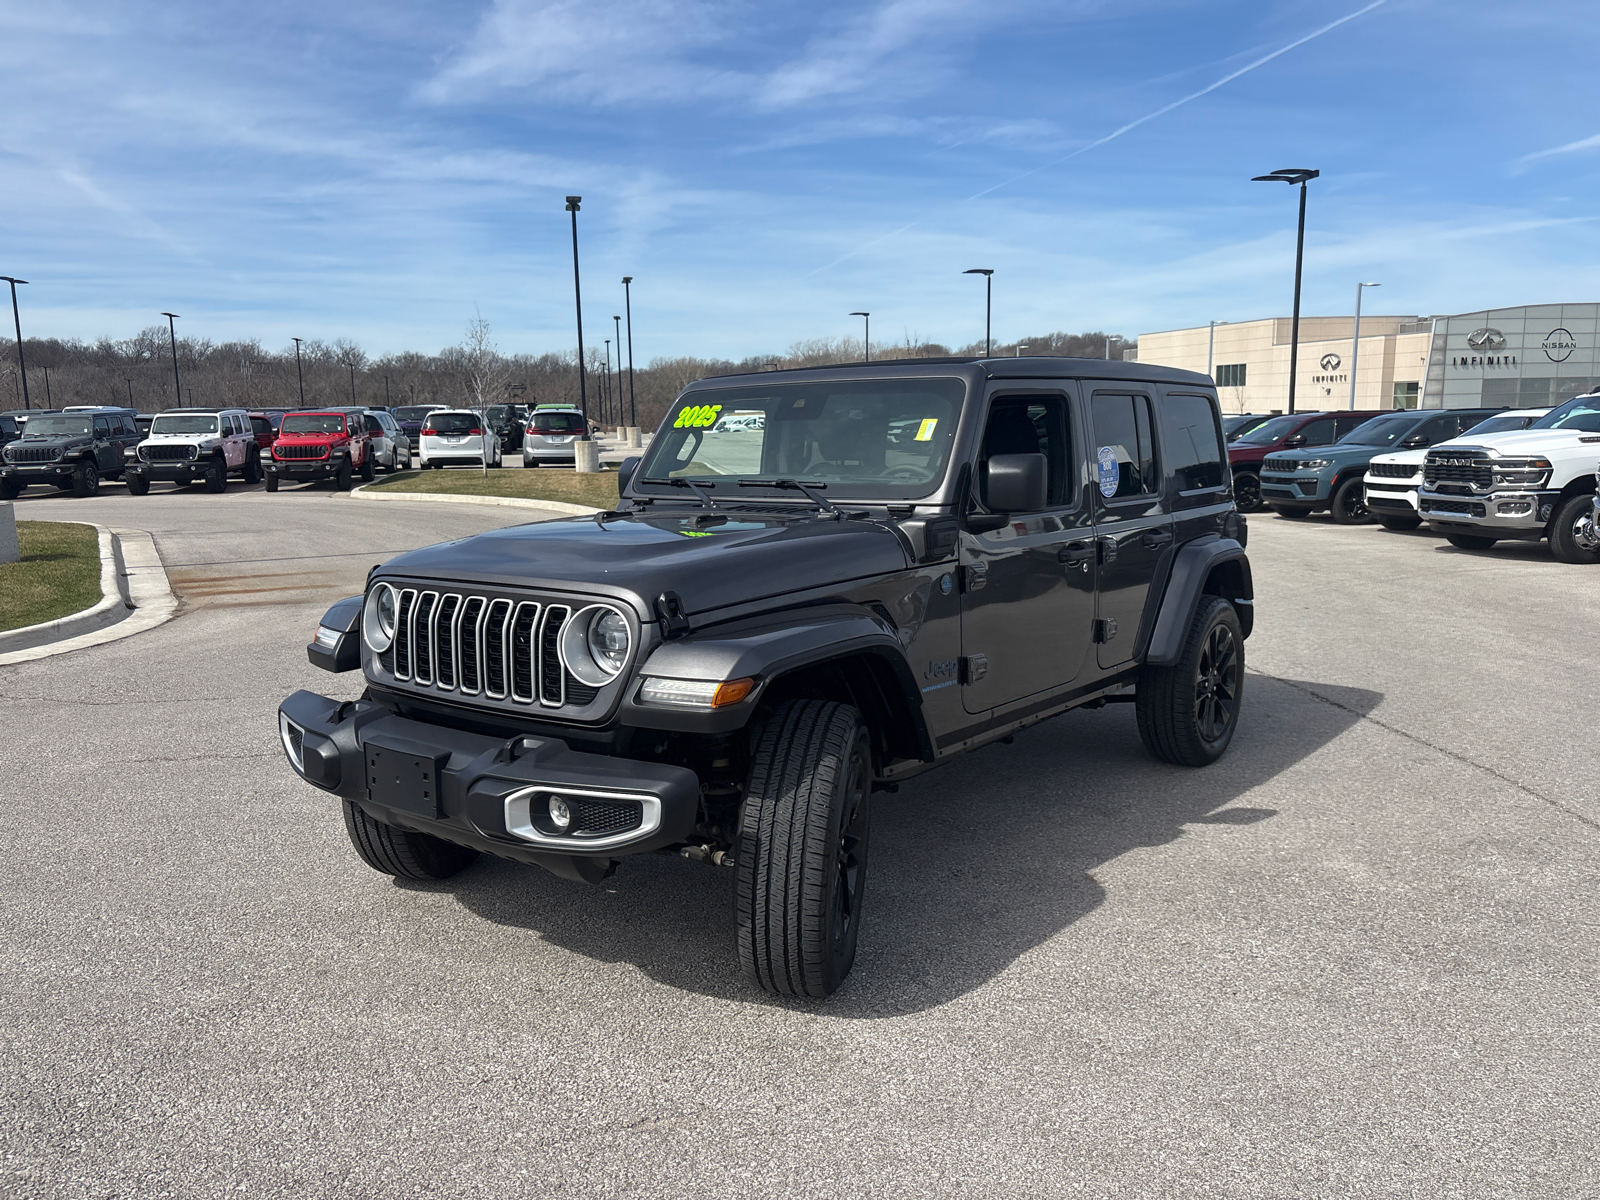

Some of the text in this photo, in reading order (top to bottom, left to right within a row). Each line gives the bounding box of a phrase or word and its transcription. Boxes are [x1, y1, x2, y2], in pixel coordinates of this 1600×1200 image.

[1453, 356, 1517, 366] INFINITI
[1312, 374, 1348, 383] INFINITI
[673, 404, 723, 428] 2025
[1435, 457, 1472, 467] RAM
